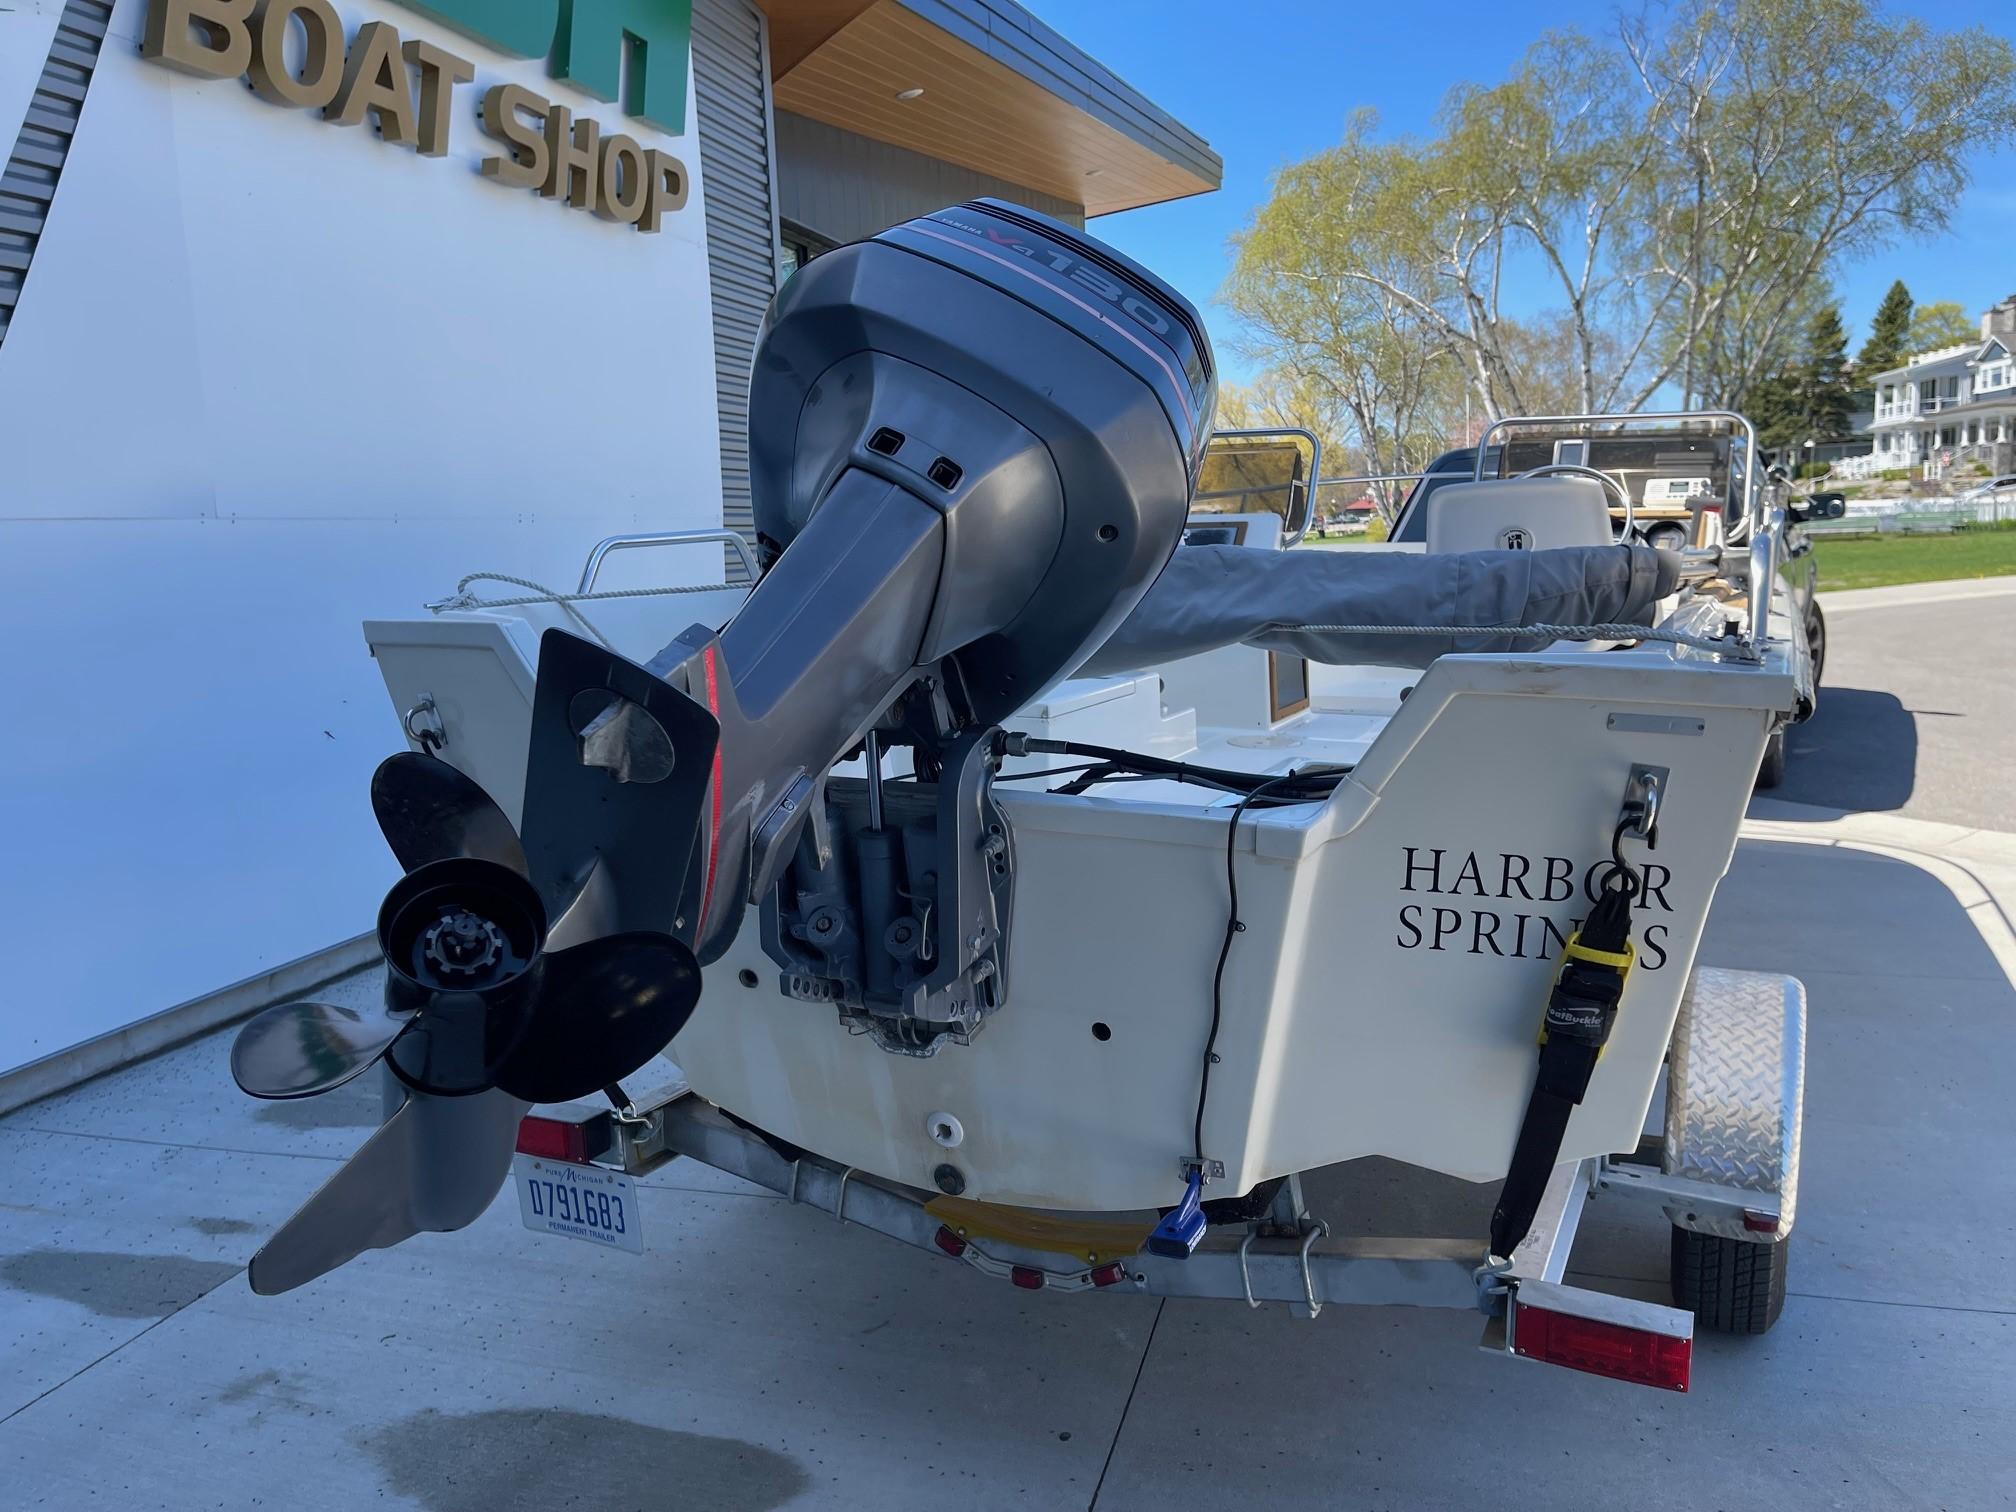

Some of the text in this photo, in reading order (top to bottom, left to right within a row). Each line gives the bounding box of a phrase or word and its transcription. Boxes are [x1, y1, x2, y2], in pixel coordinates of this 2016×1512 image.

[143, 0, 475, 156] BOAT
[482, 84, 689, 233] SHOP
[1400, 847, 1673, 911] HARBOR
[1397, 905, 1668, 970] SPRINS
[1549, 1008, 1602, 1025] oatBuckle
[529, 1179, 626, 1234] D791683
[548, 1222, 616, 1243] PERMANENT TRAILER
